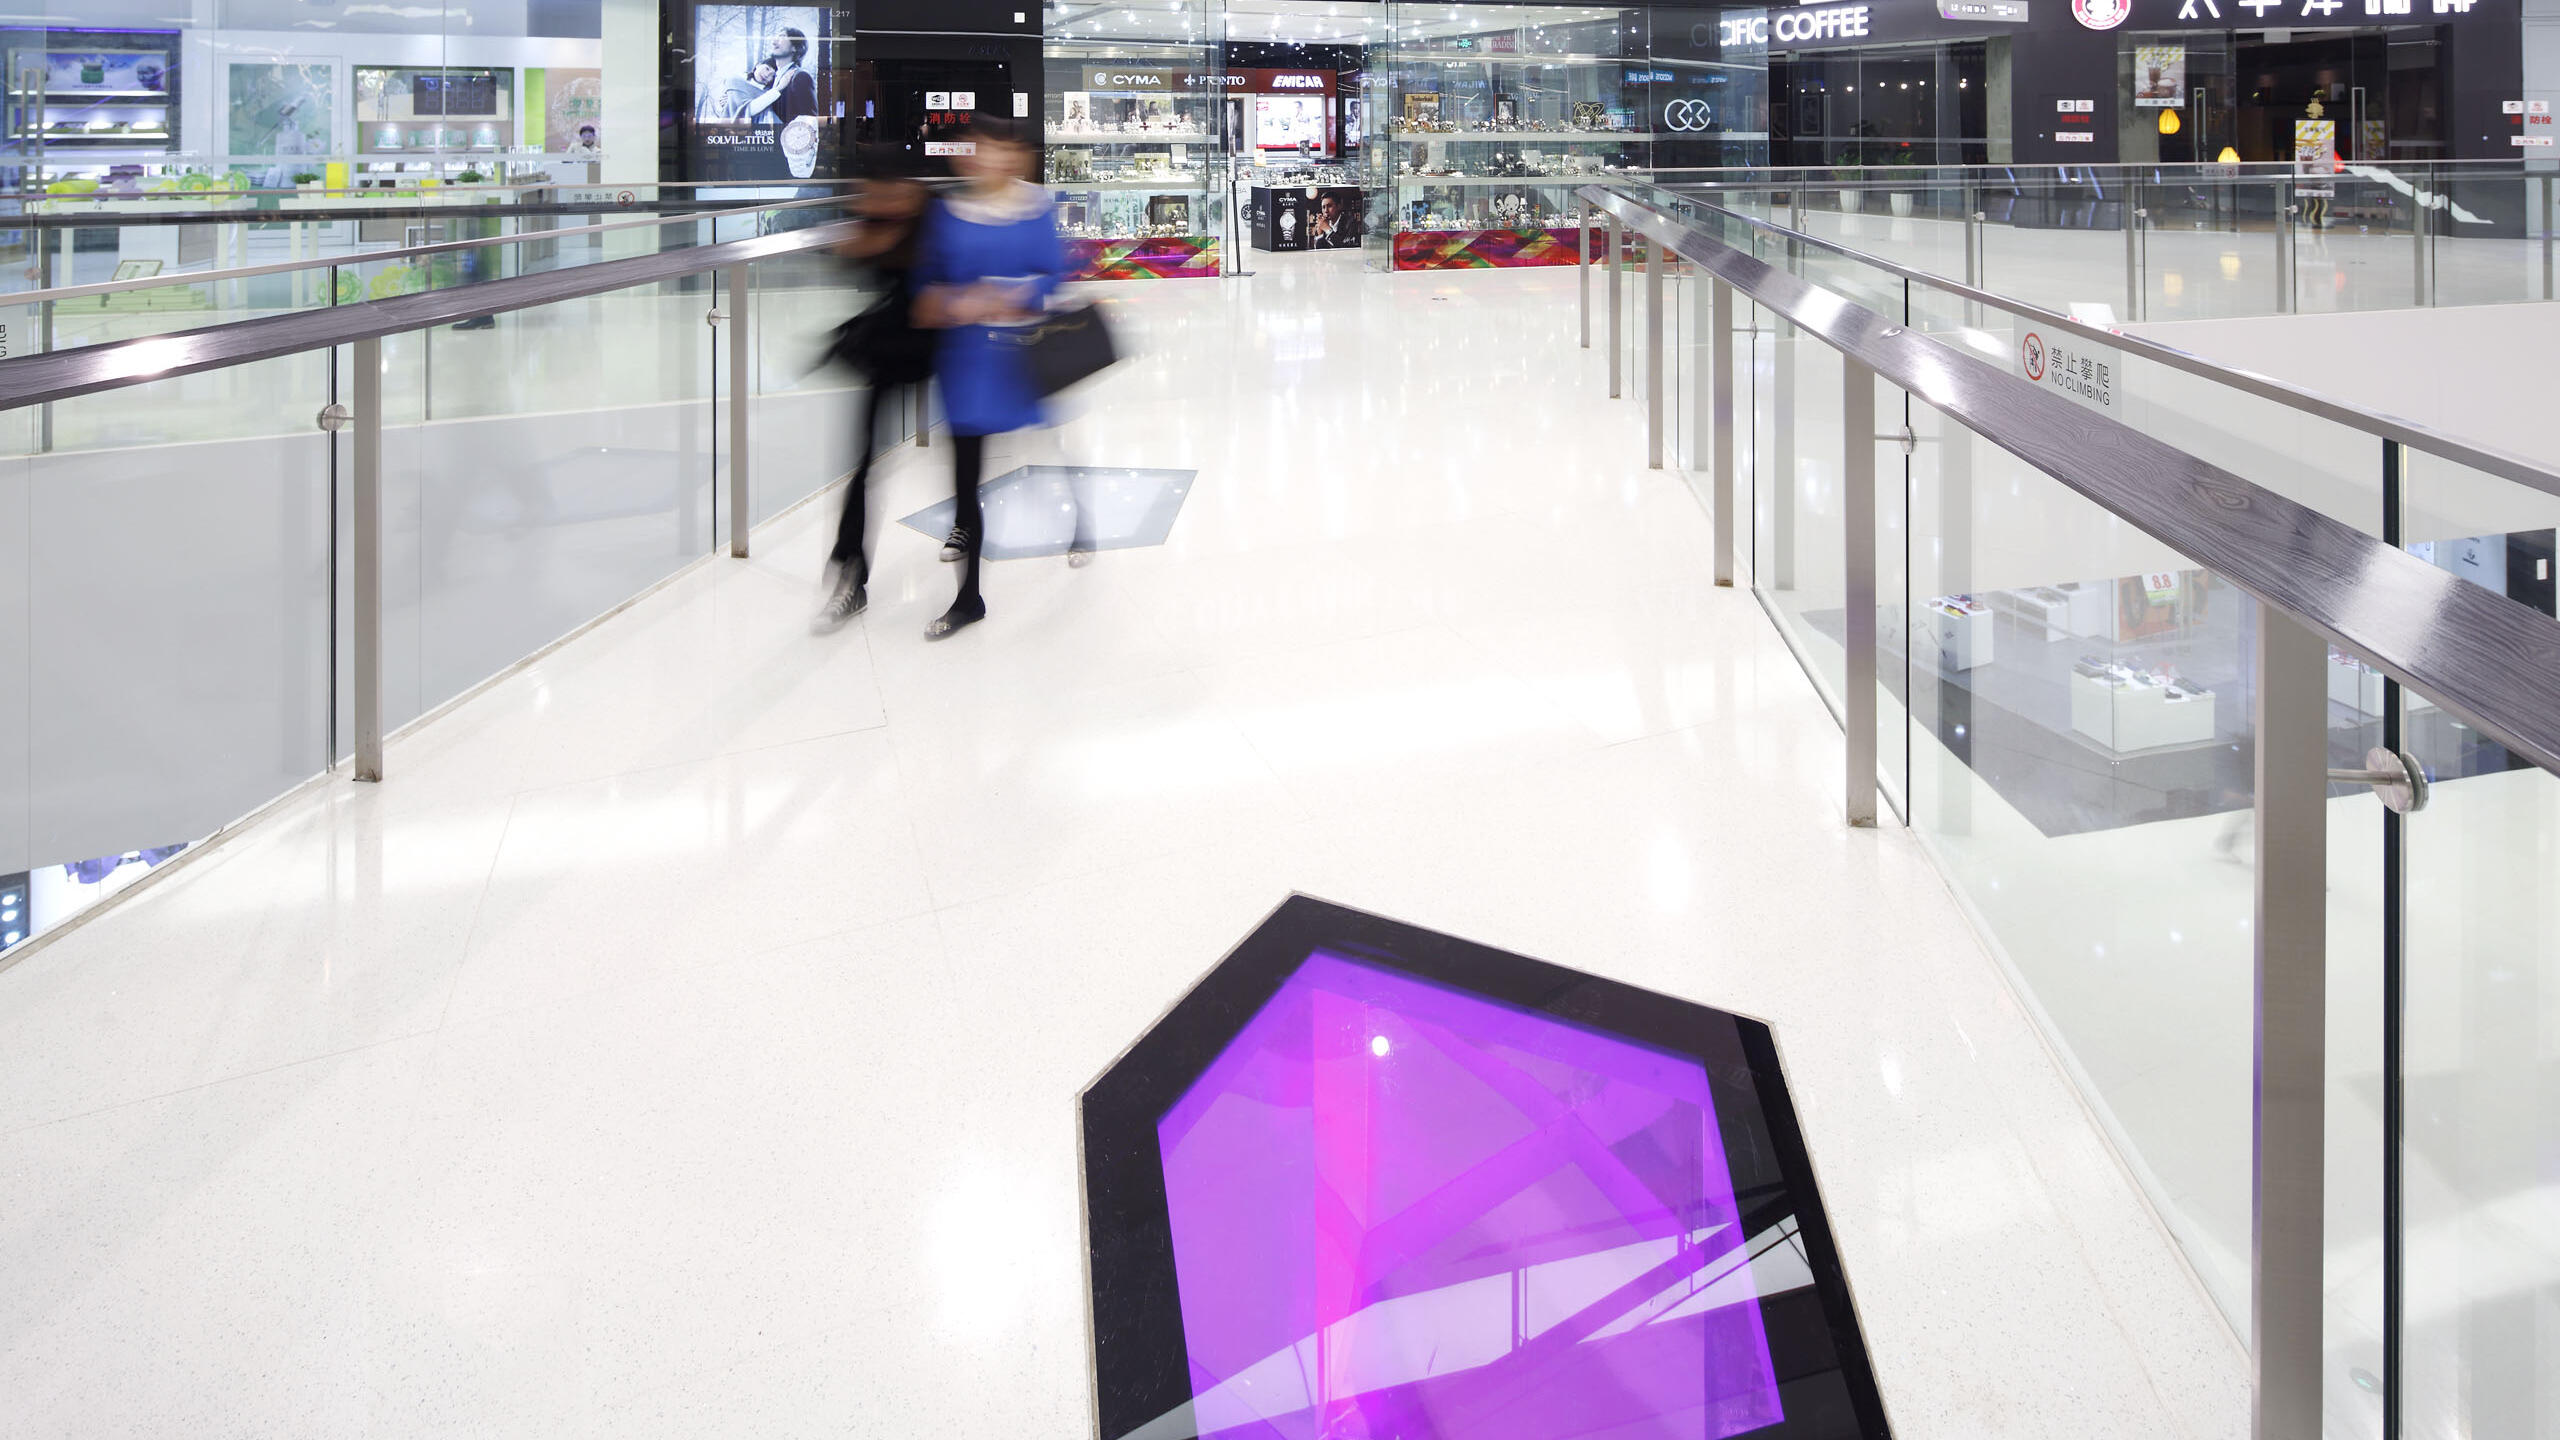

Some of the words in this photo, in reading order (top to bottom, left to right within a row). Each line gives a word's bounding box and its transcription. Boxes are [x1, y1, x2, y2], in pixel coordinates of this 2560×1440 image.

[1776, 6, 1869, 42] COFFEE
[1112, 75, 1161, 85] CYMA
[1199, 75, 1246, 86] PONTO
[1271, 75, 1324, 88] ENICAR
[707, 135, 741, 144] SOLVIL
[745, 135, 774, 144] TITUS
[2049, 346, 2110, 389] 禁止攀爬
[2051, 370, 2064, 387] NO
[2065, 375, 2111, 406] CLIMBING
